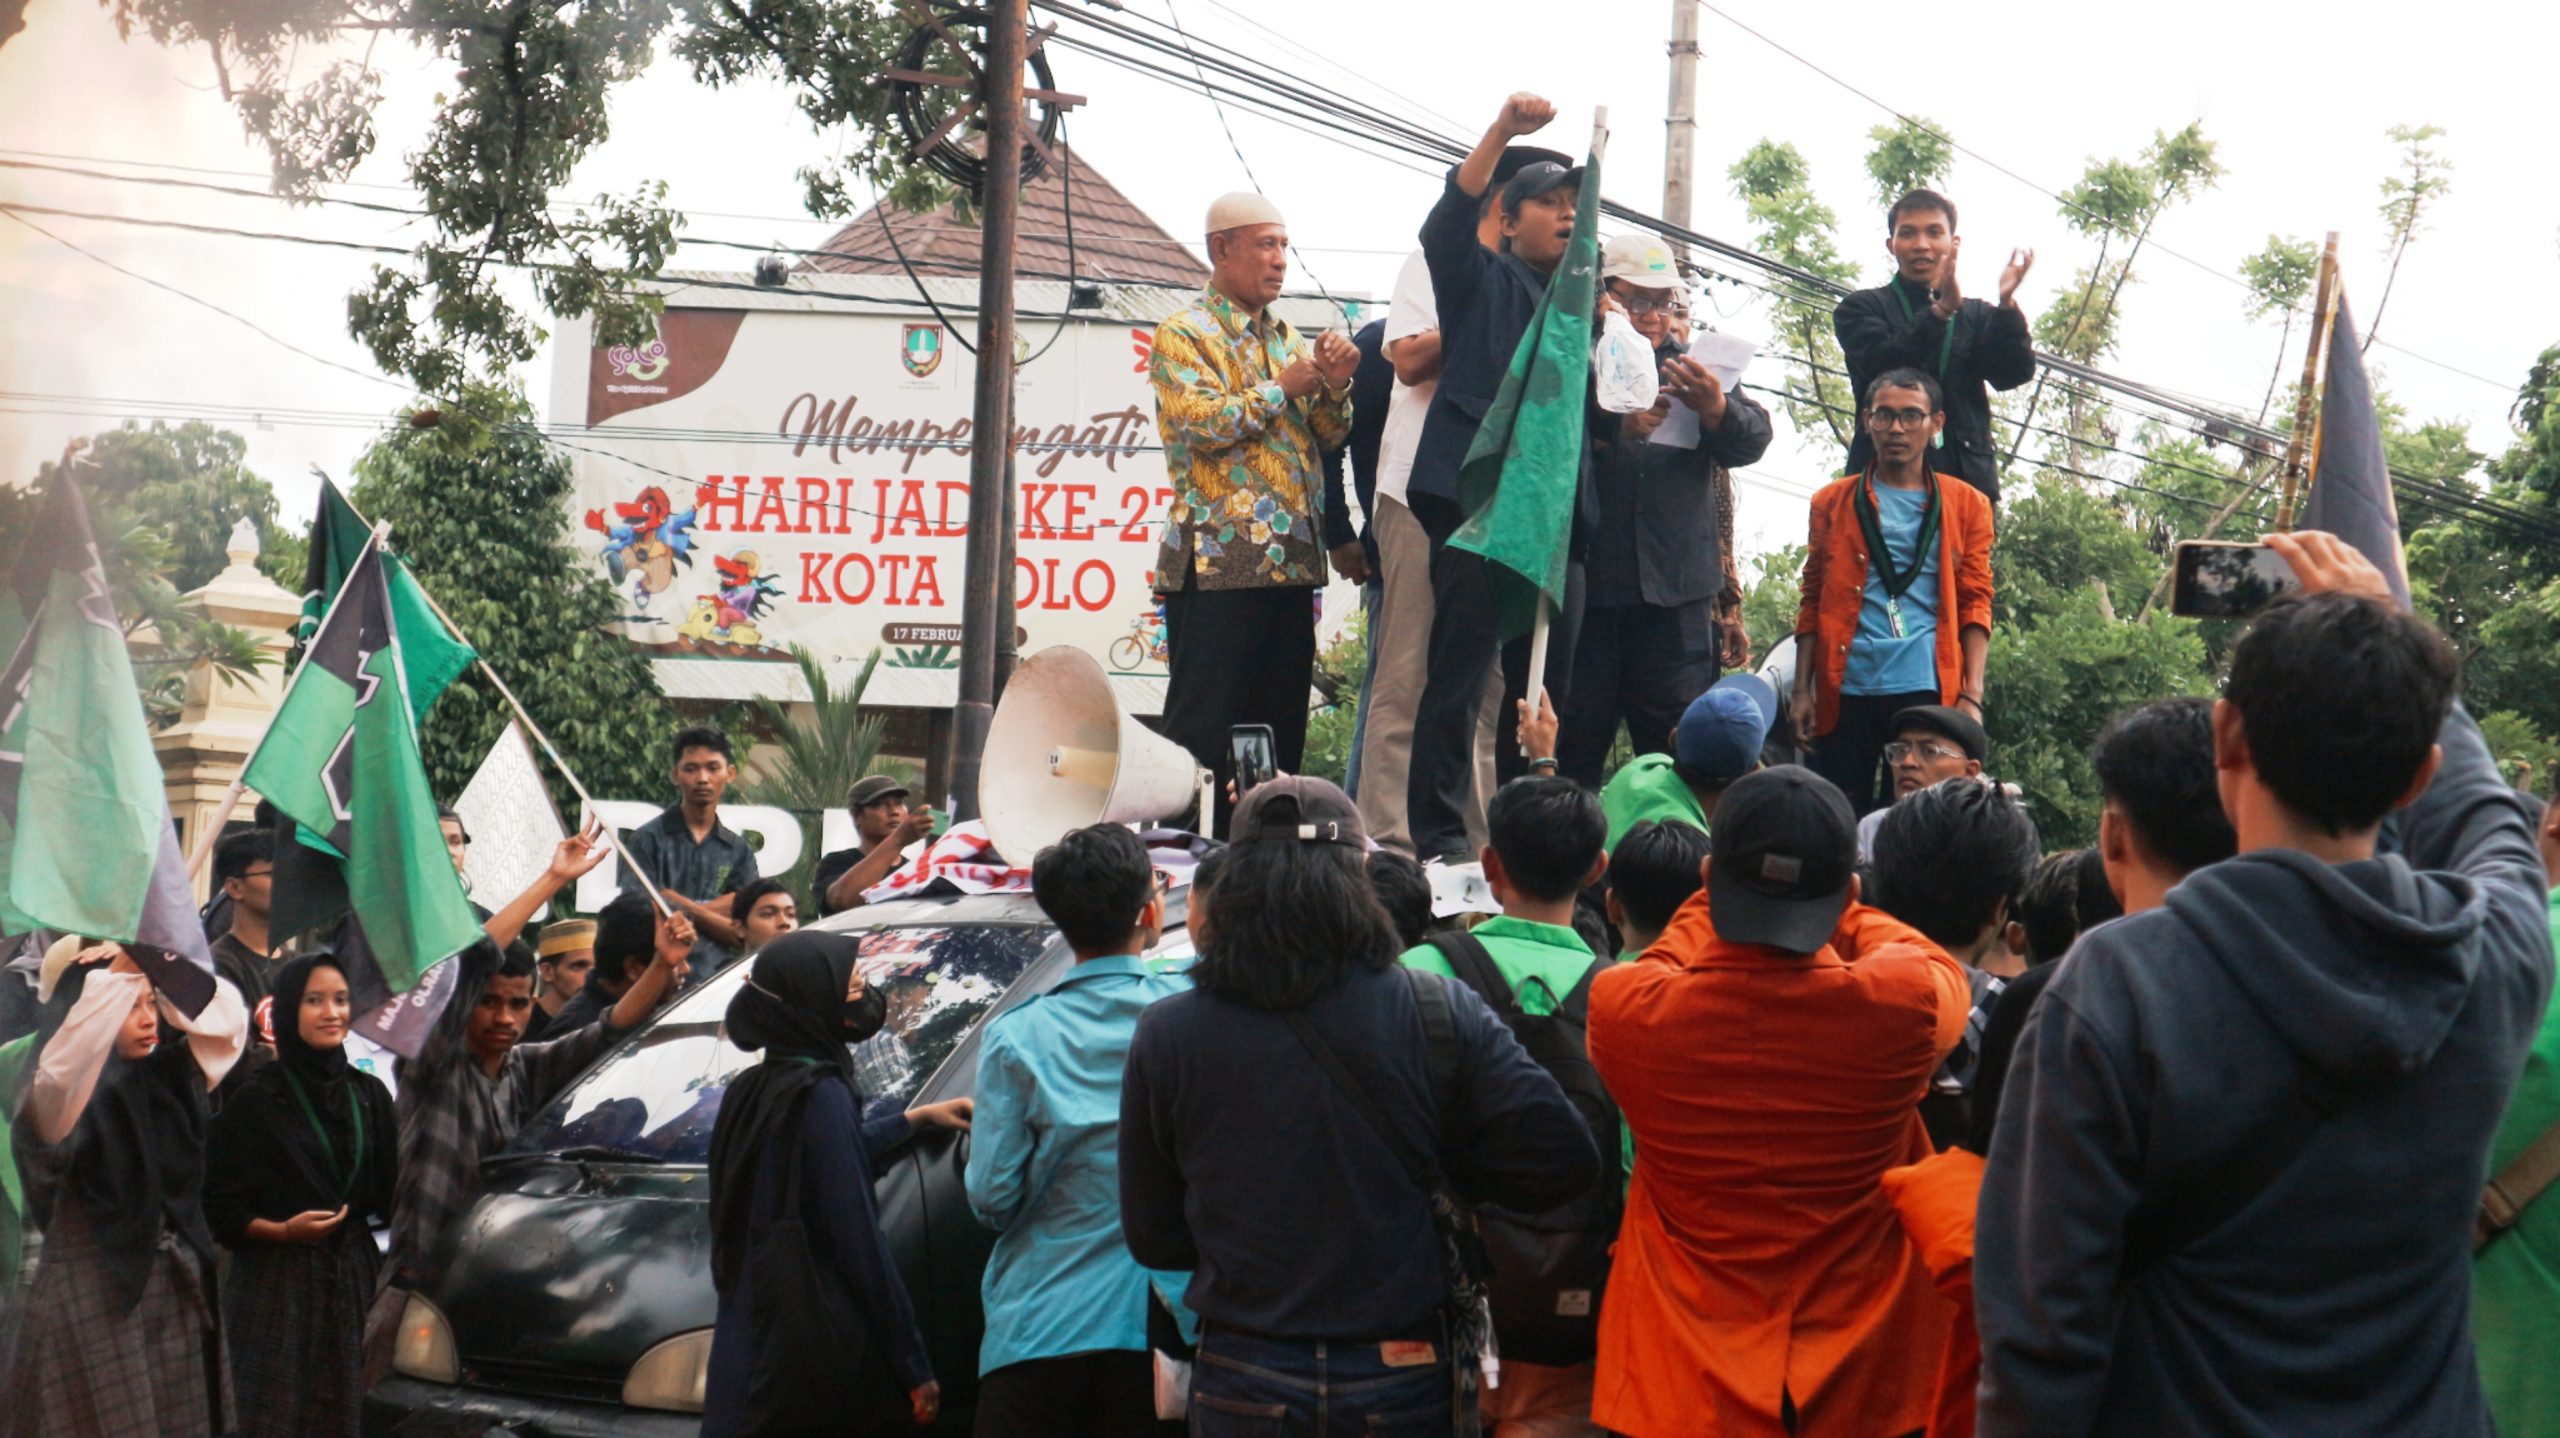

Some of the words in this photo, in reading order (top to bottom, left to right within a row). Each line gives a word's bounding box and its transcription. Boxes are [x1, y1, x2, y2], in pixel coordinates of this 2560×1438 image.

[779, 393, 1150, 478] Mempengati
[703, 475, 854, 534] HARI
[870, 479, 972, 544] JAD
[797, 552, 945, 606] KOTA
[1015, 557, 1116, 611] OLO
[893, 627, 908, 640] 17
